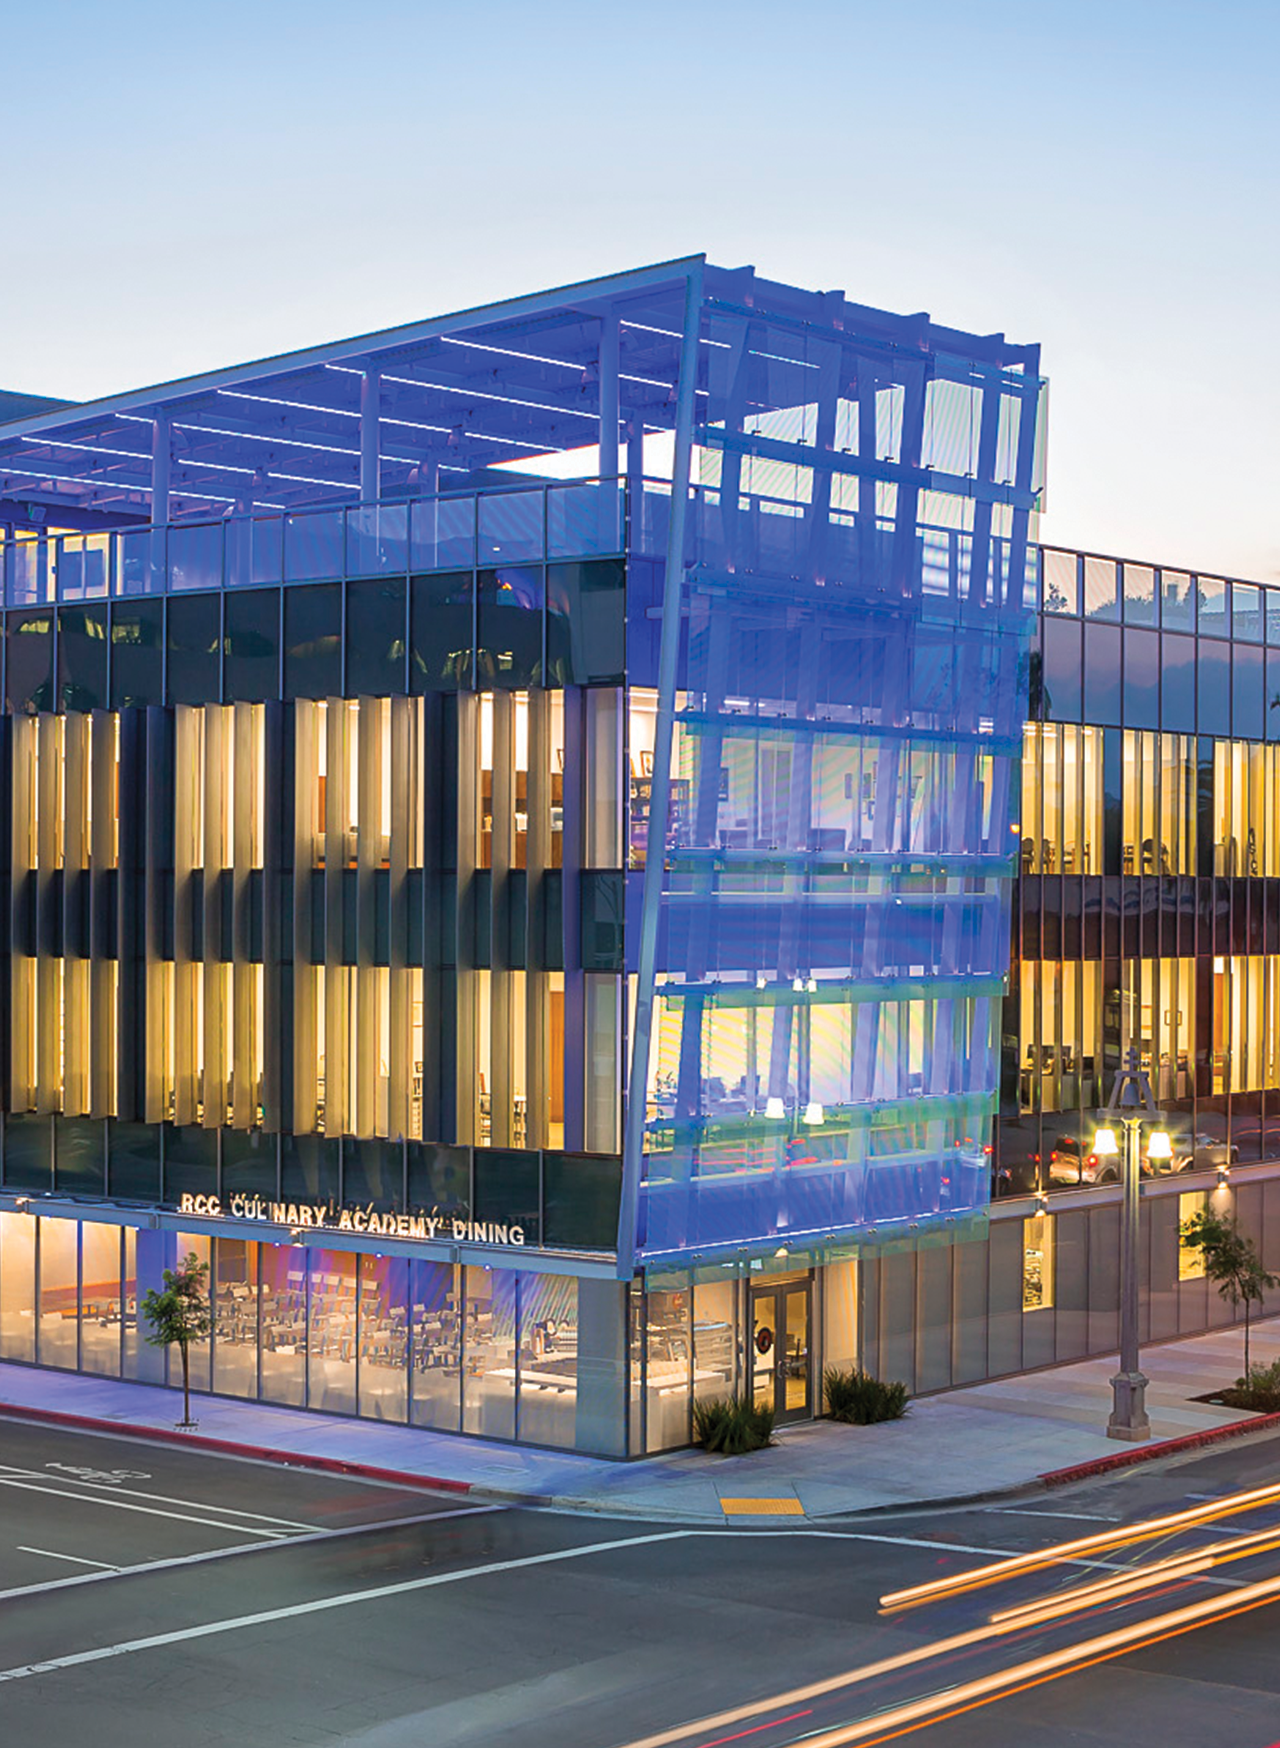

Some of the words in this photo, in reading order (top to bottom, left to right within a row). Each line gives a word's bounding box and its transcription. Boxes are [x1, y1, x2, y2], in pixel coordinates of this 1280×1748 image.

[181, 1193, 221, 1215] RCC
[231, 1199, 327, 1227] CULINARY
[339, 1209, 438, 1239] ACADEMY
[452, 1220, 525, 1246] DINING
